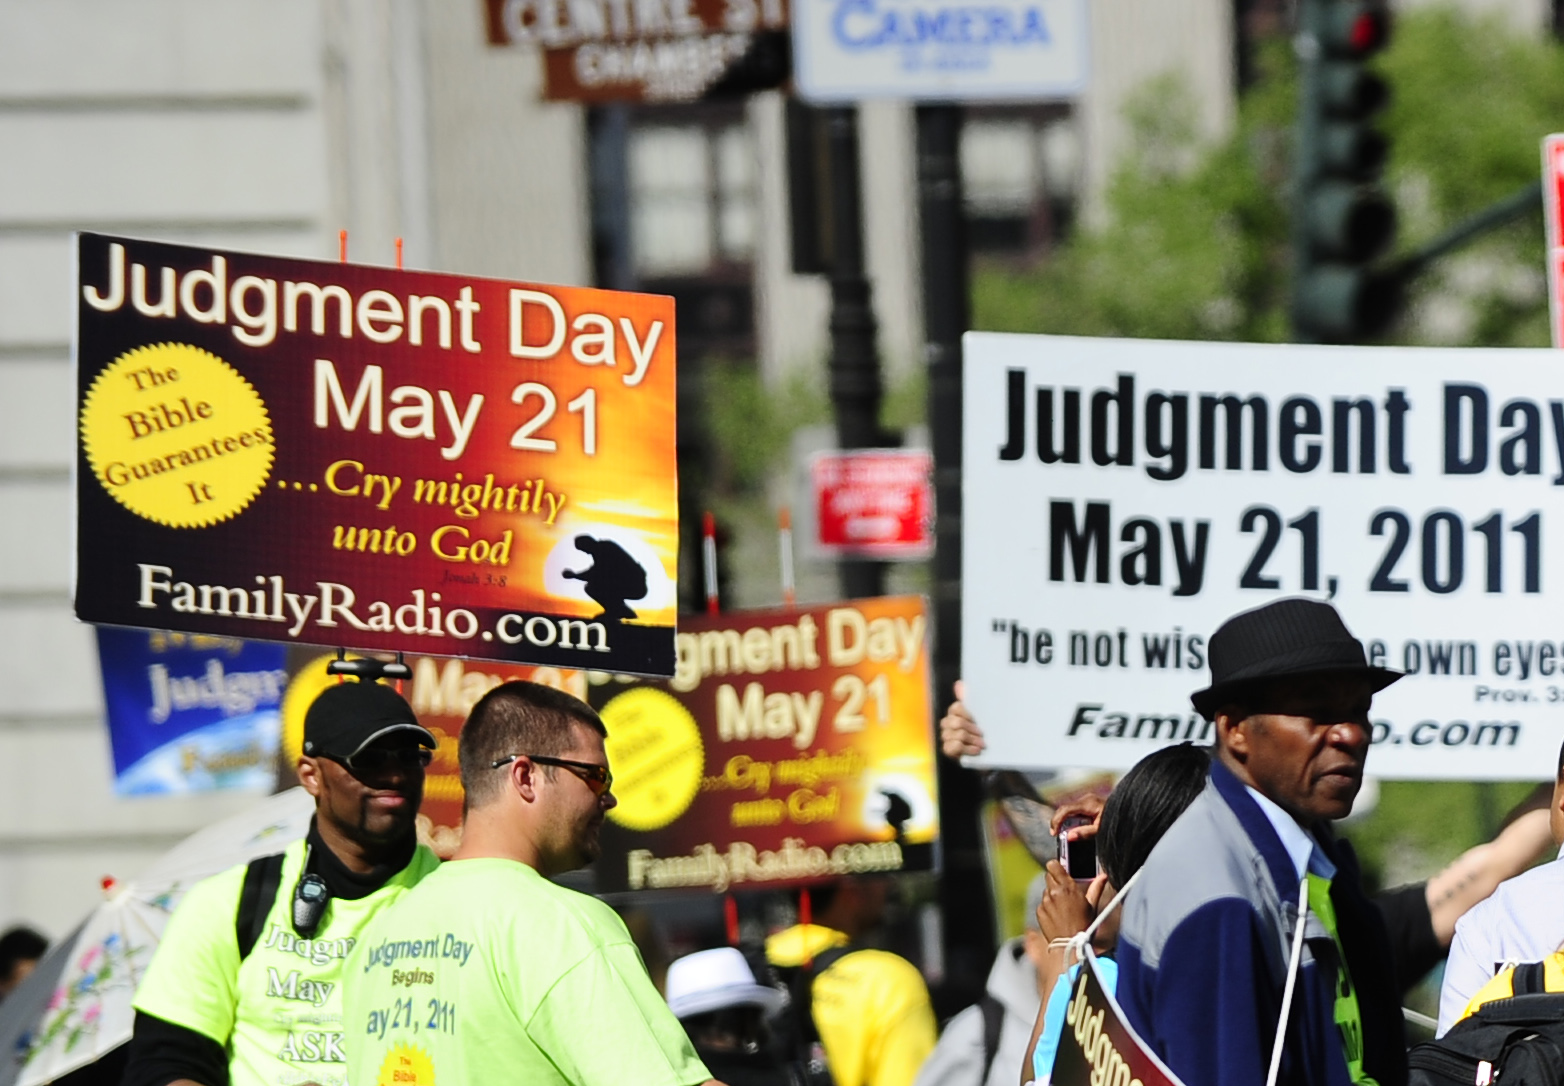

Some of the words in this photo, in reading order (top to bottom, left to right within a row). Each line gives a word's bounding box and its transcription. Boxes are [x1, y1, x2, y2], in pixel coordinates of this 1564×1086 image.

[83, 242, 481, 354] Judgment
[509, 287, 664, 386] Day
[126, 364, 180, 393] The
[123, 396, 215, 440] Bible
[313, 359, 485, 461] May
[510, 380, 598, 455] 21
[998, 367, 1411, 482] Judgment
[104, 426, 271, 488] Guarantees
[186, 481, 213, 506] It
[413, 471, 567, 525] mightily
[332, 523, 417, 558] unto
[430, 524, 514, 567] God
[1048, 498, 1212, 597] May
[1238, 505, 1338, 600] 21,
[1369, 508, 1543, 595] 2011
[136, 562, 611, 655] FamilyRadio.com
[826, 606, 927, 673] Day
[991, 619, 1054, 665] "be
[1069, 627, 1129, 669] not
[1142, 626, 1207, 670] wis
[1403, 639, 1478, 678] own
[715, 681, 824, 750] May
[830, 673, 892, 734] 21
[1474, 684, 1538, 705] Prov.
[364, 935, 440, 974] Judgment
[441, 933, 475, 968] Day
[266, 966, 335, 1008] May
[391, 967, 435, 988] Begins
[366, 1007, 391, 1042] ay
[277, 1030, 347, 1064] ASK
